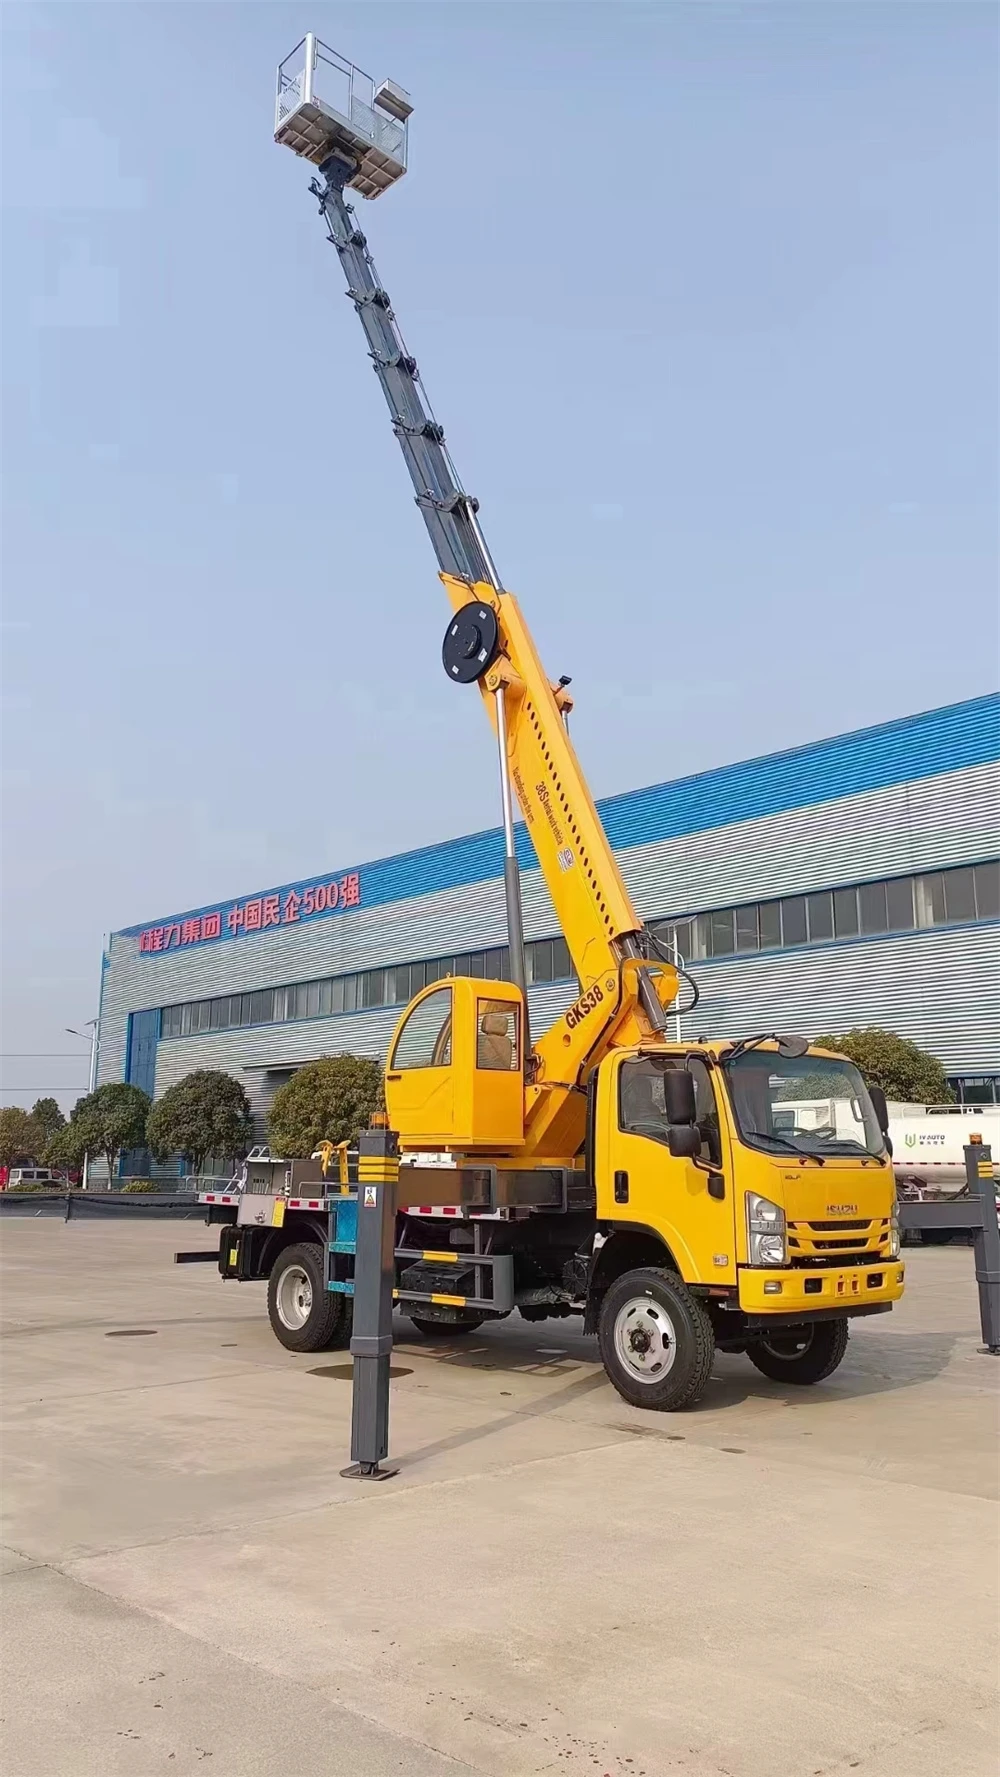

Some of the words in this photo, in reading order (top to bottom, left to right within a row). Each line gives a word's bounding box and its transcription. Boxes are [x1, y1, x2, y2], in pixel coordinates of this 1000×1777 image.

[535, 781, 549, 802] 38S
[548, 814, 558, 829] work
[227, 872, 360, 936] 中国民企500强
[565, 984, 604, 1030] GKS38
[826, 1204, 859, 1215] ISUZU
